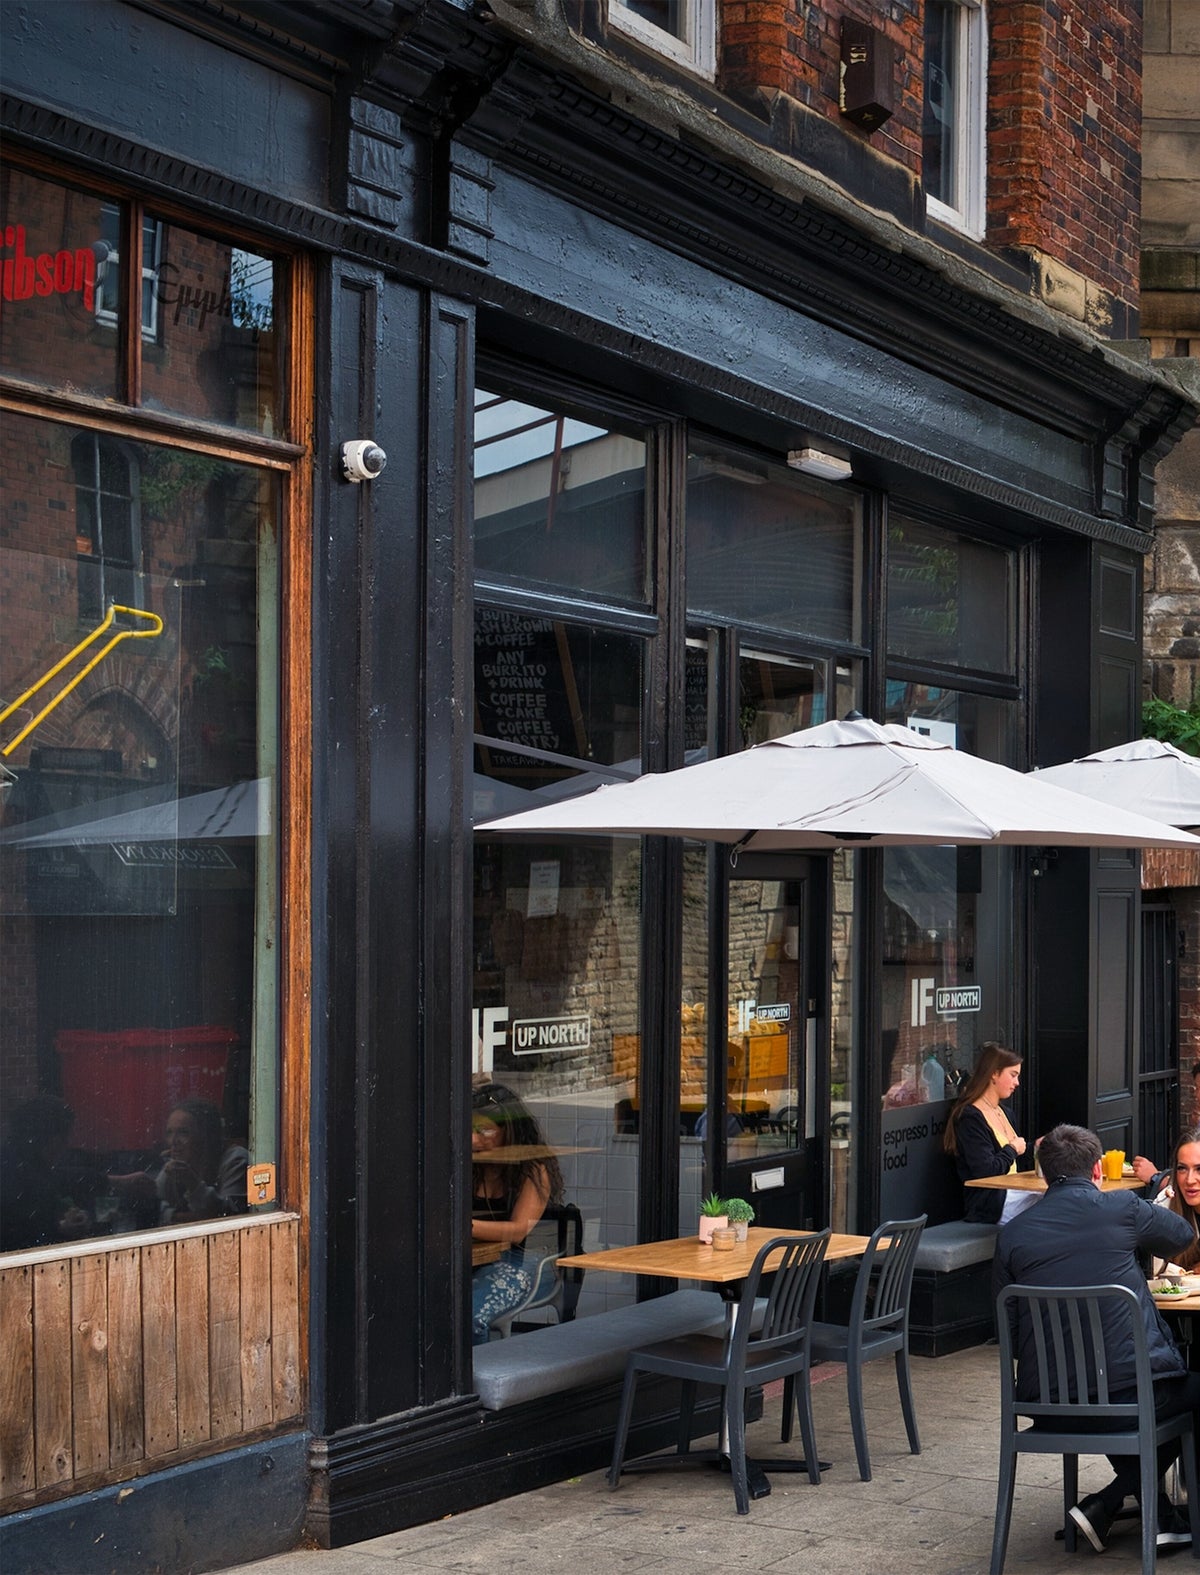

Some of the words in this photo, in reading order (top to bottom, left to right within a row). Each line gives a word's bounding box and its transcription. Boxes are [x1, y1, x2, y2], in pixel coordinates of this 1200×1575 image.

[0, 224, 95, 312] ibson
[155, 262, 260, 342] Epiph
[474, 621, 501, 634] ASH
[496, 649, 525, 666] ANY
[481, 663, 547, 678] BURRITO
[490, 692, 547, 708] COFFEE
[496, 720, 554, 735] COFFEE
[911, 978, 935, 1027] IF
[939, 993, 950, 1008] UP
[951, 991, 978, 1007] NORTH
[738, 999, 756, 1033] IF
[758, 1009, 768, 1020] UP
[768, 1007, 788, 1019] NORTH
[472, 1007, 509, 1073] IF
[517, 1027, 537, 1047] UP
[539, 1023, 586, 1045] NORTH
[884, 1125, 928, 1148] espresso
[884, 1146, 907, 1171] food
